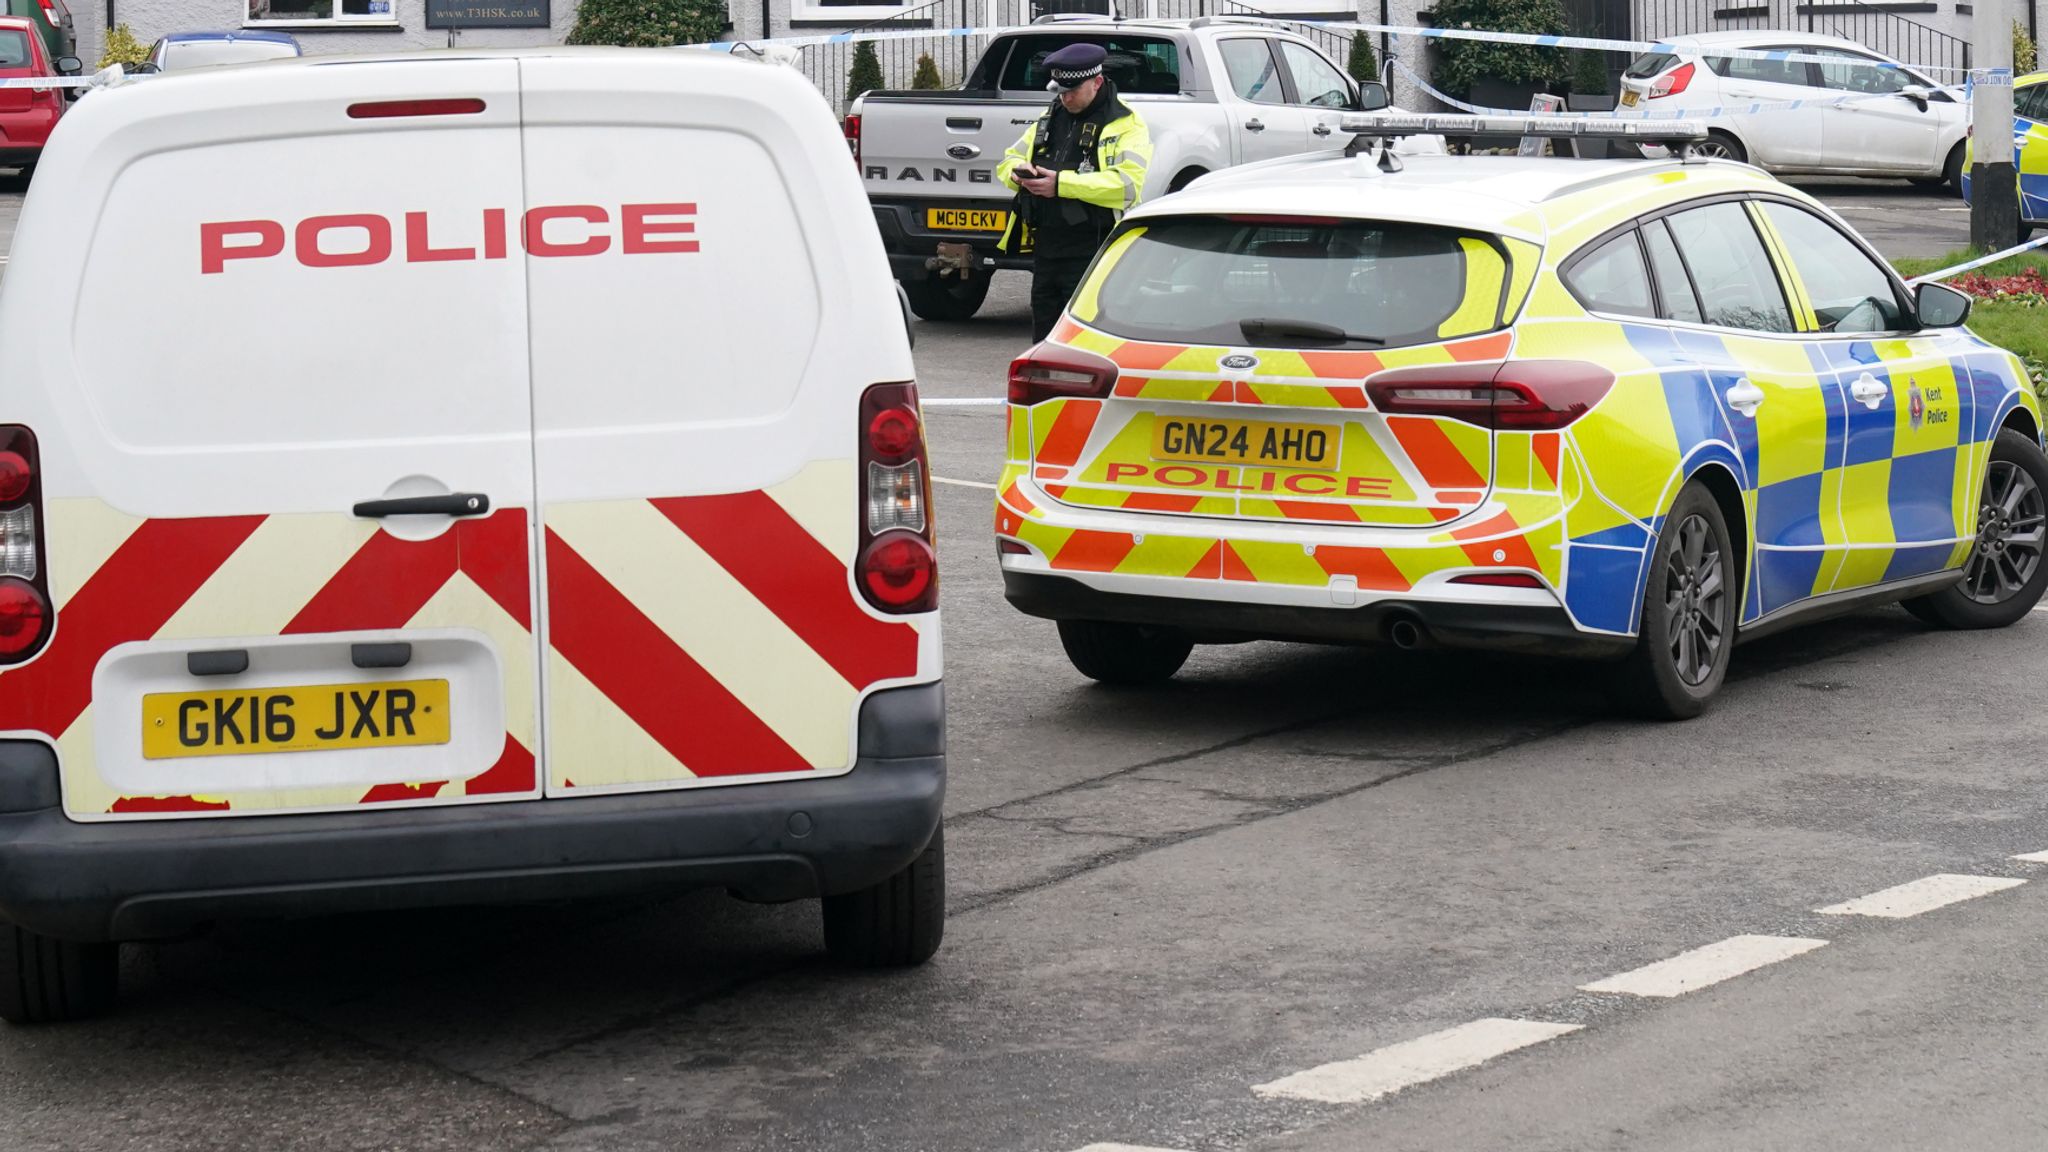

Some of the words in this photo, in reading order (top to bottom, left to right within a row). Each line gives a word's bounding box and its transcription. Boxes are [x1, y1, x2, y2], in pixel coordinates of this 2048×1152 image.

[436, 8, 541, 18] www.T3HSK.co.uk
[866, 166, 992, 183] RANG
[936, 210, 967, 226] MC19
[971, 212, 998, 227] CKV
[200, 202, 700, 274] POLICE
[1226, 356, 1251, 367] Ford
[1924, 386, 1942, 401] Kent
[1927, 408, 1948, 424] Police
[1162, 421, 1249, 457] GN24
[1259, 427, 1326, 462] AHO
[1105, 462, 1393, 498] POLICE
[178, 694, 296, 747] GK16
[314, 688, 416, 740] JXR
